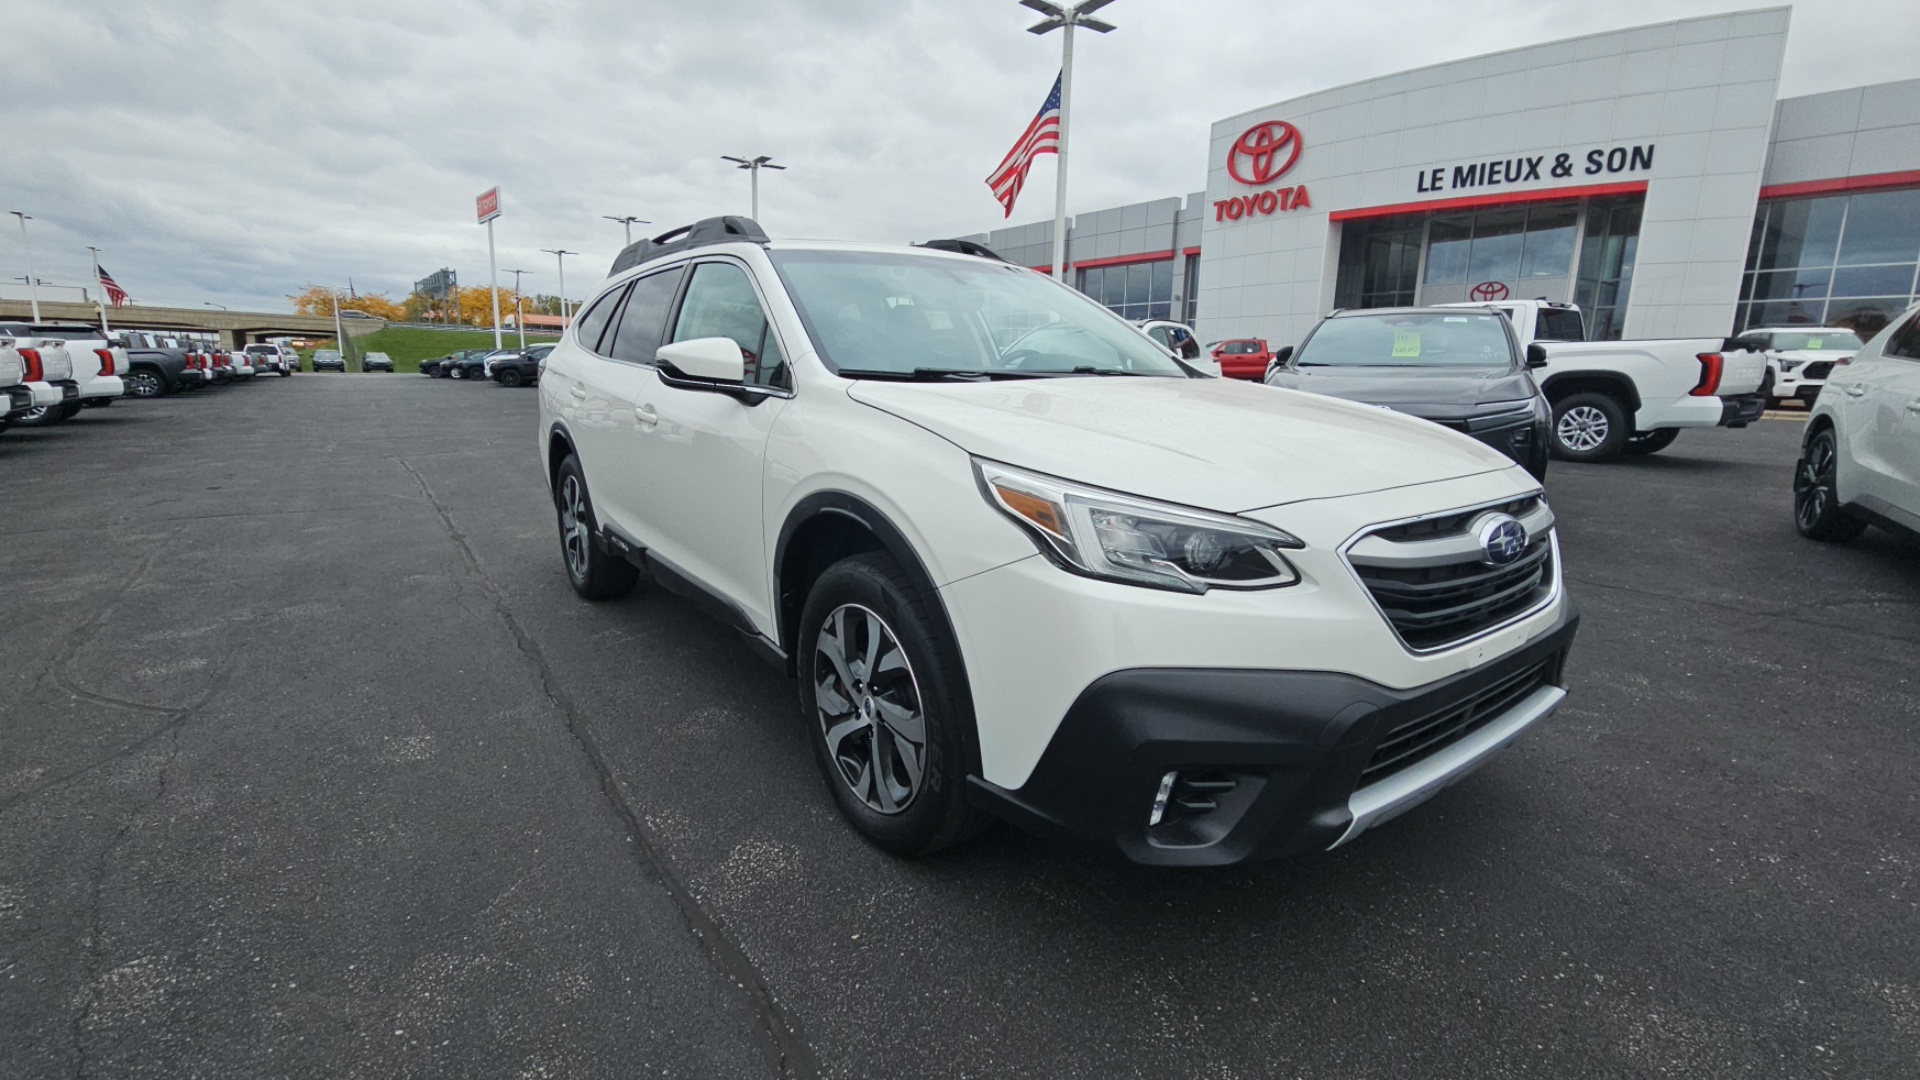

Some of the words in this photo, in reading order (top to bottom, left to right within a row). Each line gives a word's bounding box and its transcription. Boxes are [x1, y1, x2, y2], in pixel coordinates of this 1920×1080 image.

[1416, 167, 1445, 193] LE
[1451, 155, 1545, 189] MIEUX
[1550, 153, 1573, 178] &
[1584, 144, 1655, 175] SON
[1213, 184, 1311, 222] TOYOTA
